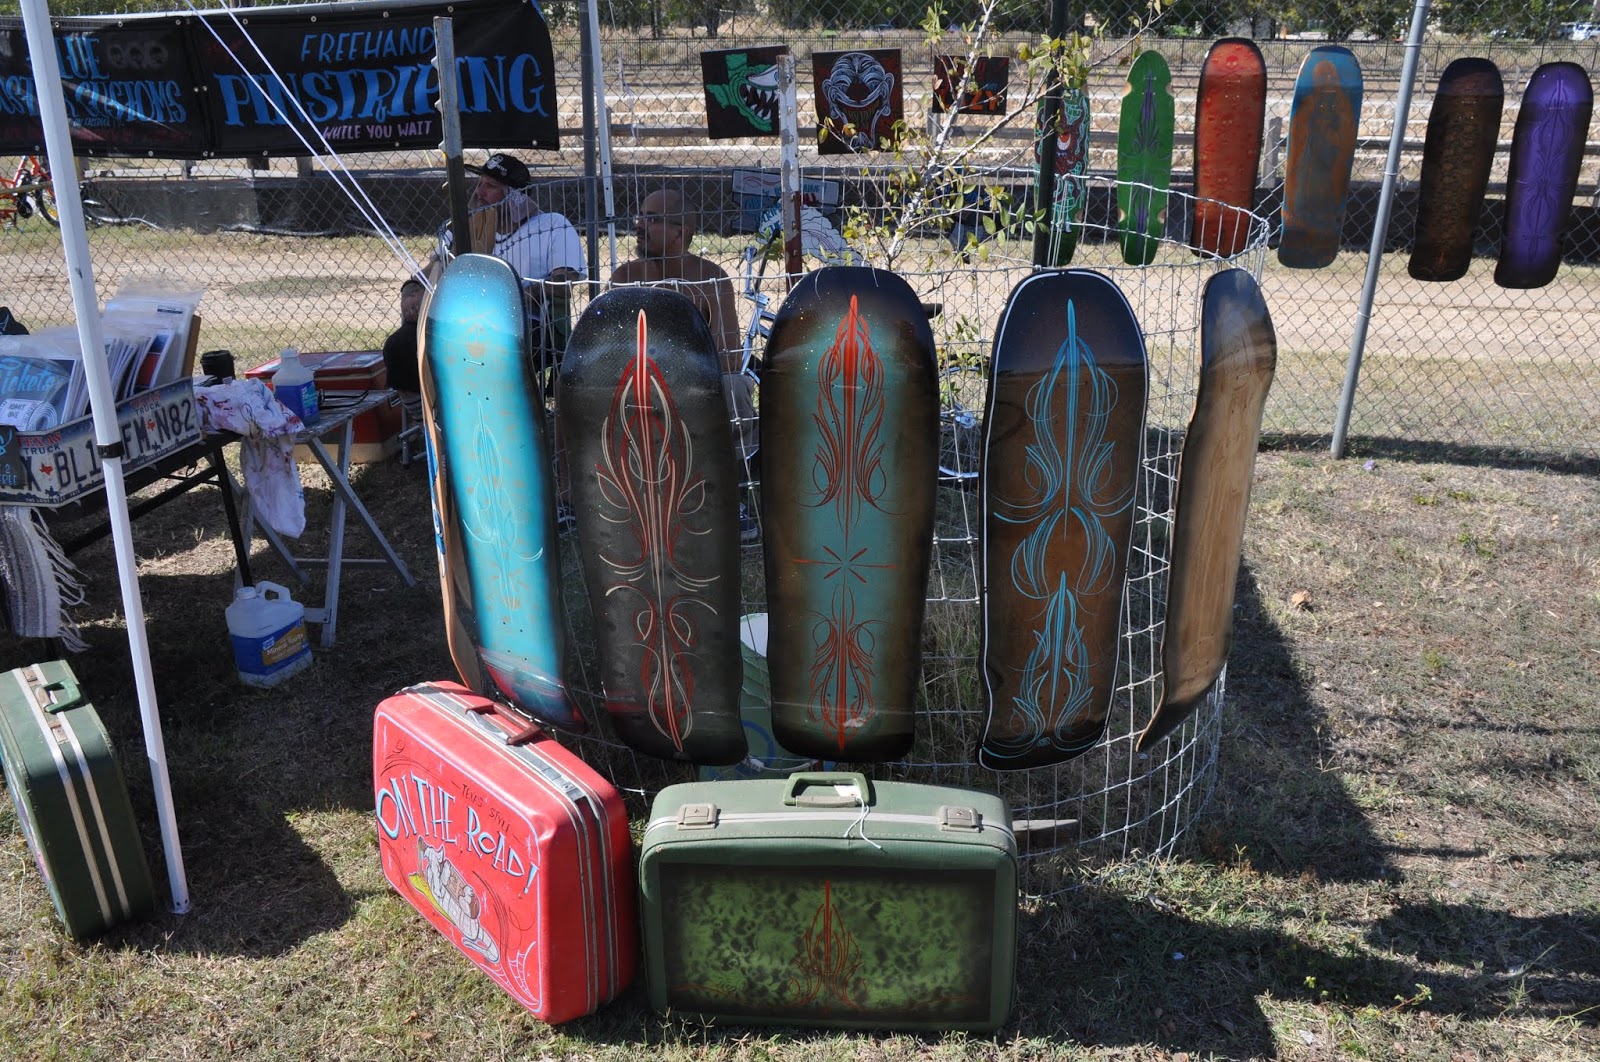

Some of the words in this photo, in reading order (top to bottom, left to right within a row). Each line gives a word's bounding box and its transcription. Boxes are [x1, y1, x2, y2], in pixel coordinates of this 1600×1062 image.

[27, 35, 110, 79] LUE
[301, 26, 435, 62] FREEHAND
[75, 80, 187, 123] CUSTOMS
[213, 53, 549, 126] PINSTRIPING
[322, 125, 361, 141] WHILE
[366, 123, 393, 139] YOU
[397, 120, 432, 137] WAIT
[135, 402, 160, 415] TRUCK
[16, 432, 62, 447] TEXAS
[23, 444, 60, 455] TRUCK
[121, 416, 151, 459] FM
[376, 775, 418, 840] ON
[408, 771, 458, 844] THE
[462, 783, 483, 808] TEXAS
